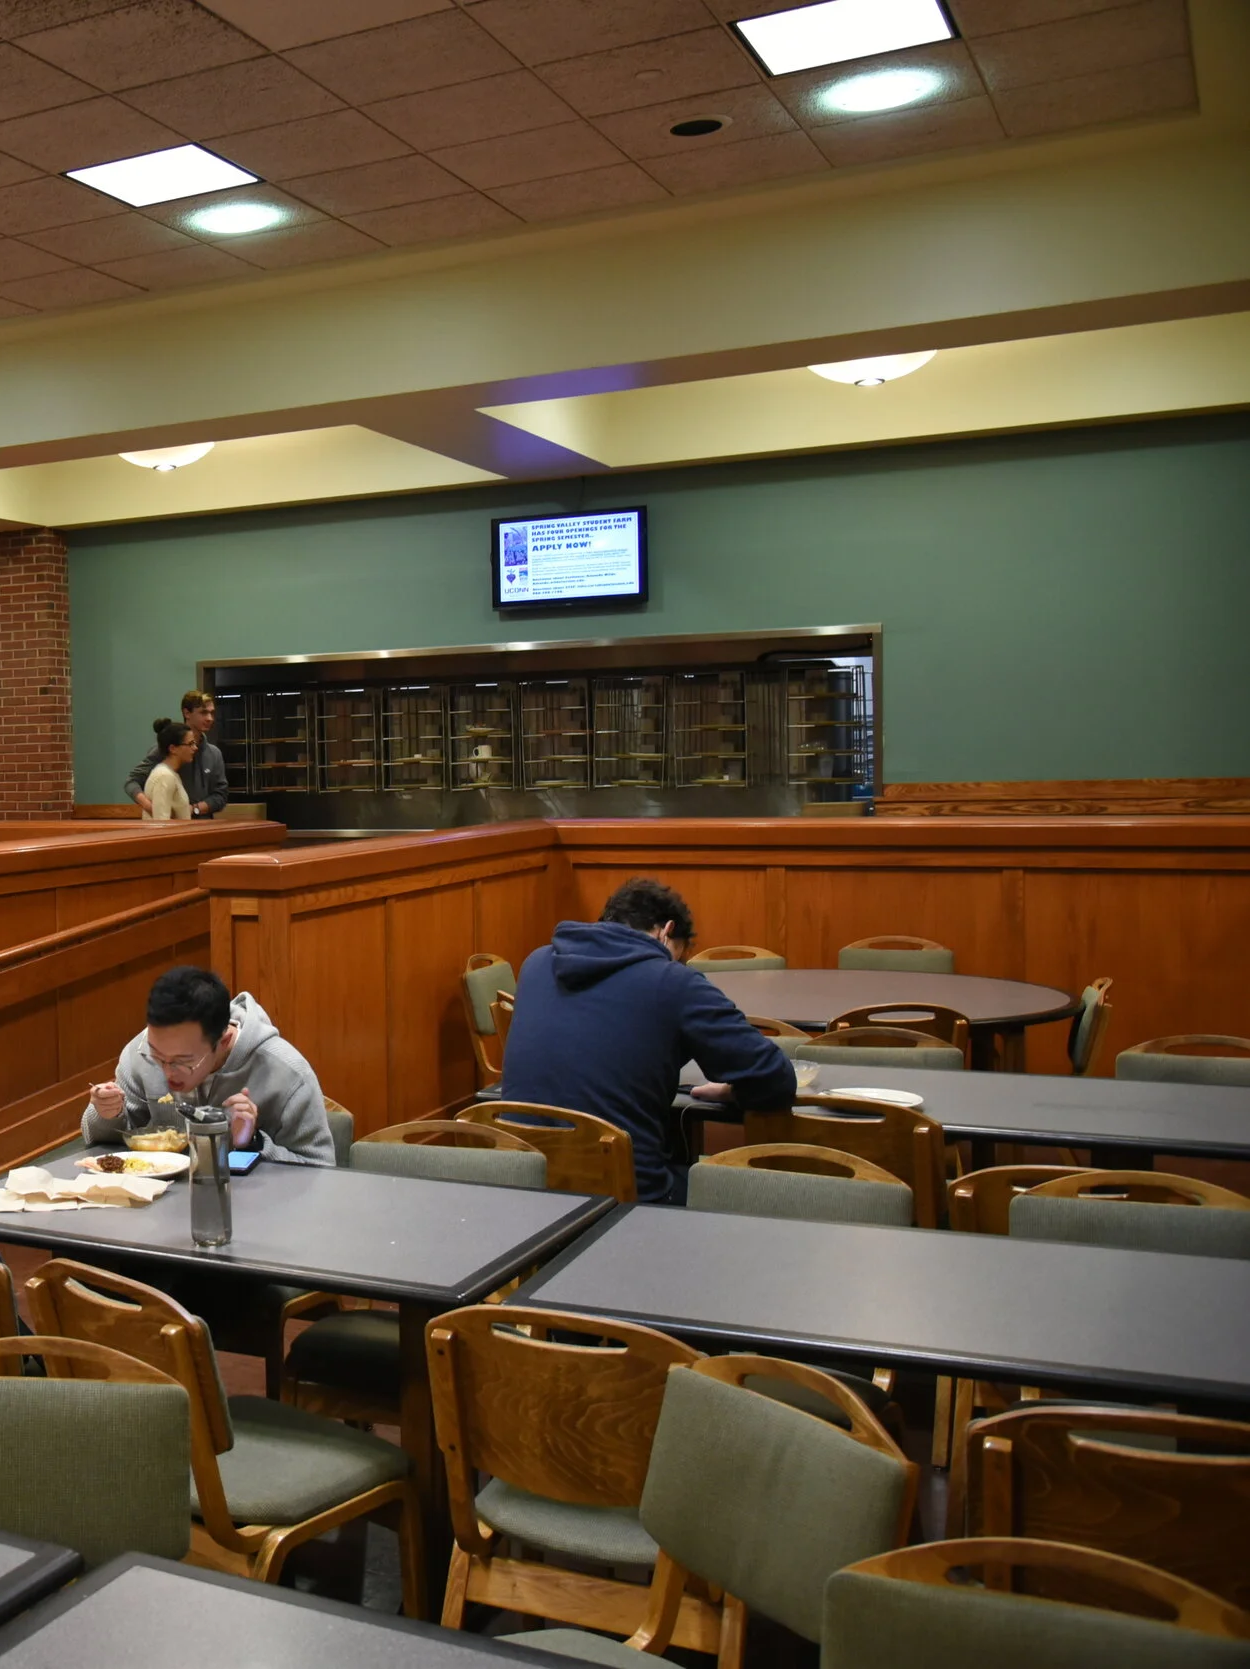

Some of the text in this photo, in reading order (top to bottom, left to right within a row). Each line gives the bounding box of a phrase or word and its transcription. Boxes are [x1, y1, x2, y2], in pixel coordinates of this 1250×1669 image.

[582, 518, 612, 526] STUDENT
[532, 541, 592, 552] APPLY NOW!
